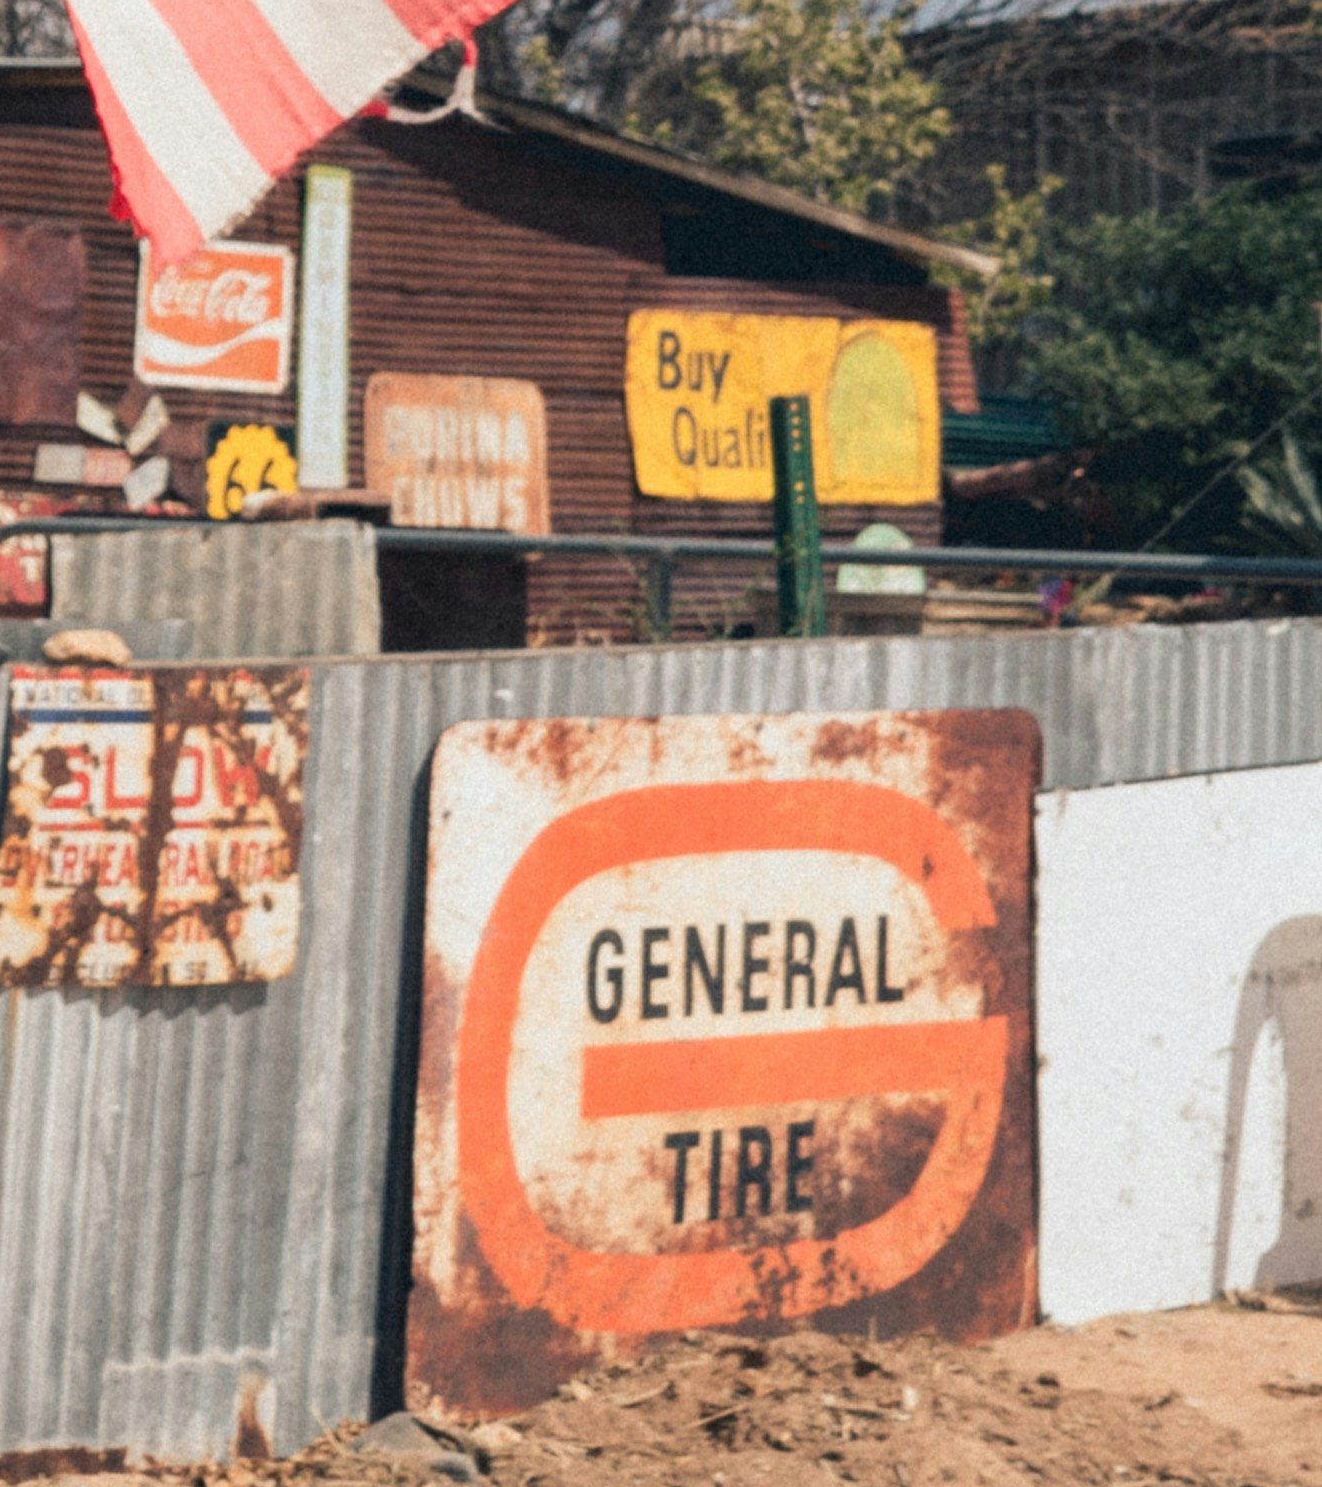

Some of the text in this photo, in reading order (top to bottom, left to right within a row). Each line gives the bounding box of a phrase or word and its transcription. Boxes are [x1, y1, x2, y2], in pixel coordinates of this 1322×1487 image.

[656, 332, 731, 402] Buy
[586, 914, 906, 1025] GENERAL
[663, 1120, 815, 1225] TIRE
